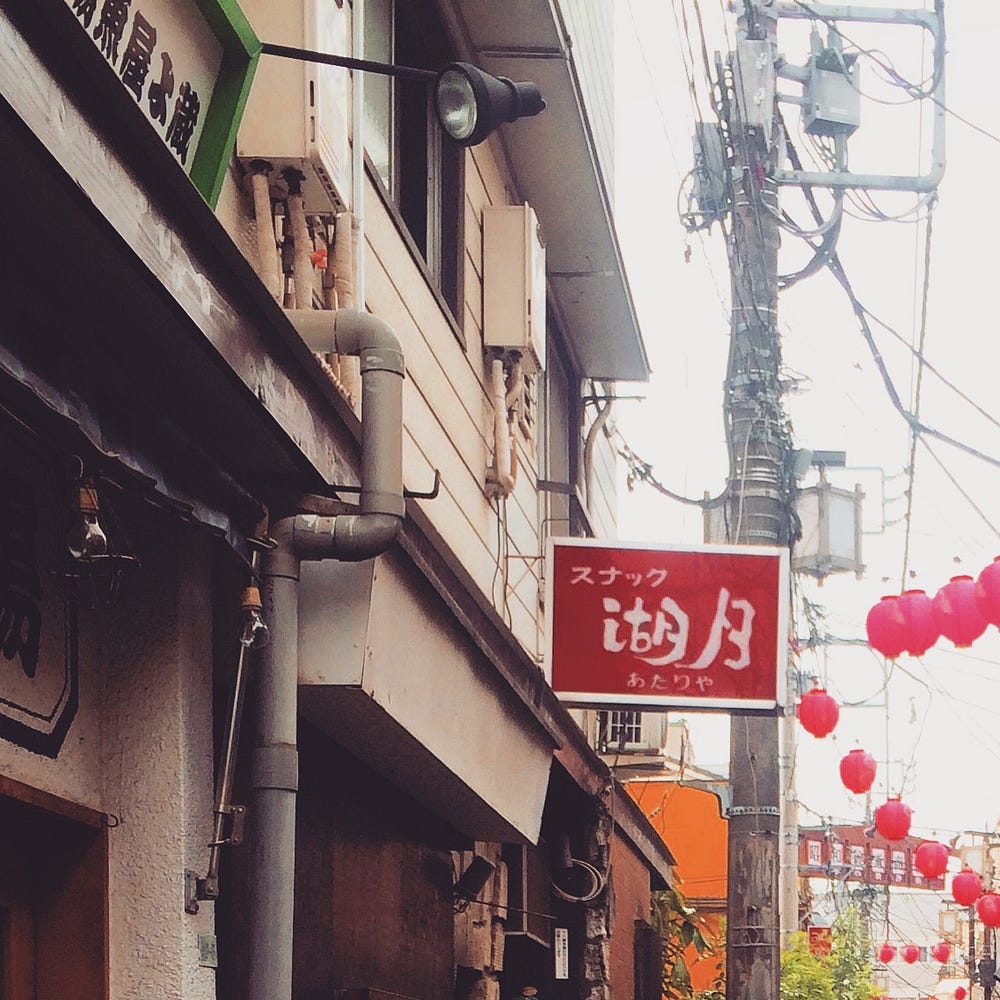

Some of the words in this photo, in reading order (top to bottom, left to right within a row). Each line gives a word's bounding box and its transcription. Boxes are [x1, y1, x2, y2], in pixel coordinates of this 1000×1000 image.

[570, 566, 668, 588] スナック
[602, 587, 756, 671] 湖月
[626, 671, 714, 692] あたりや
